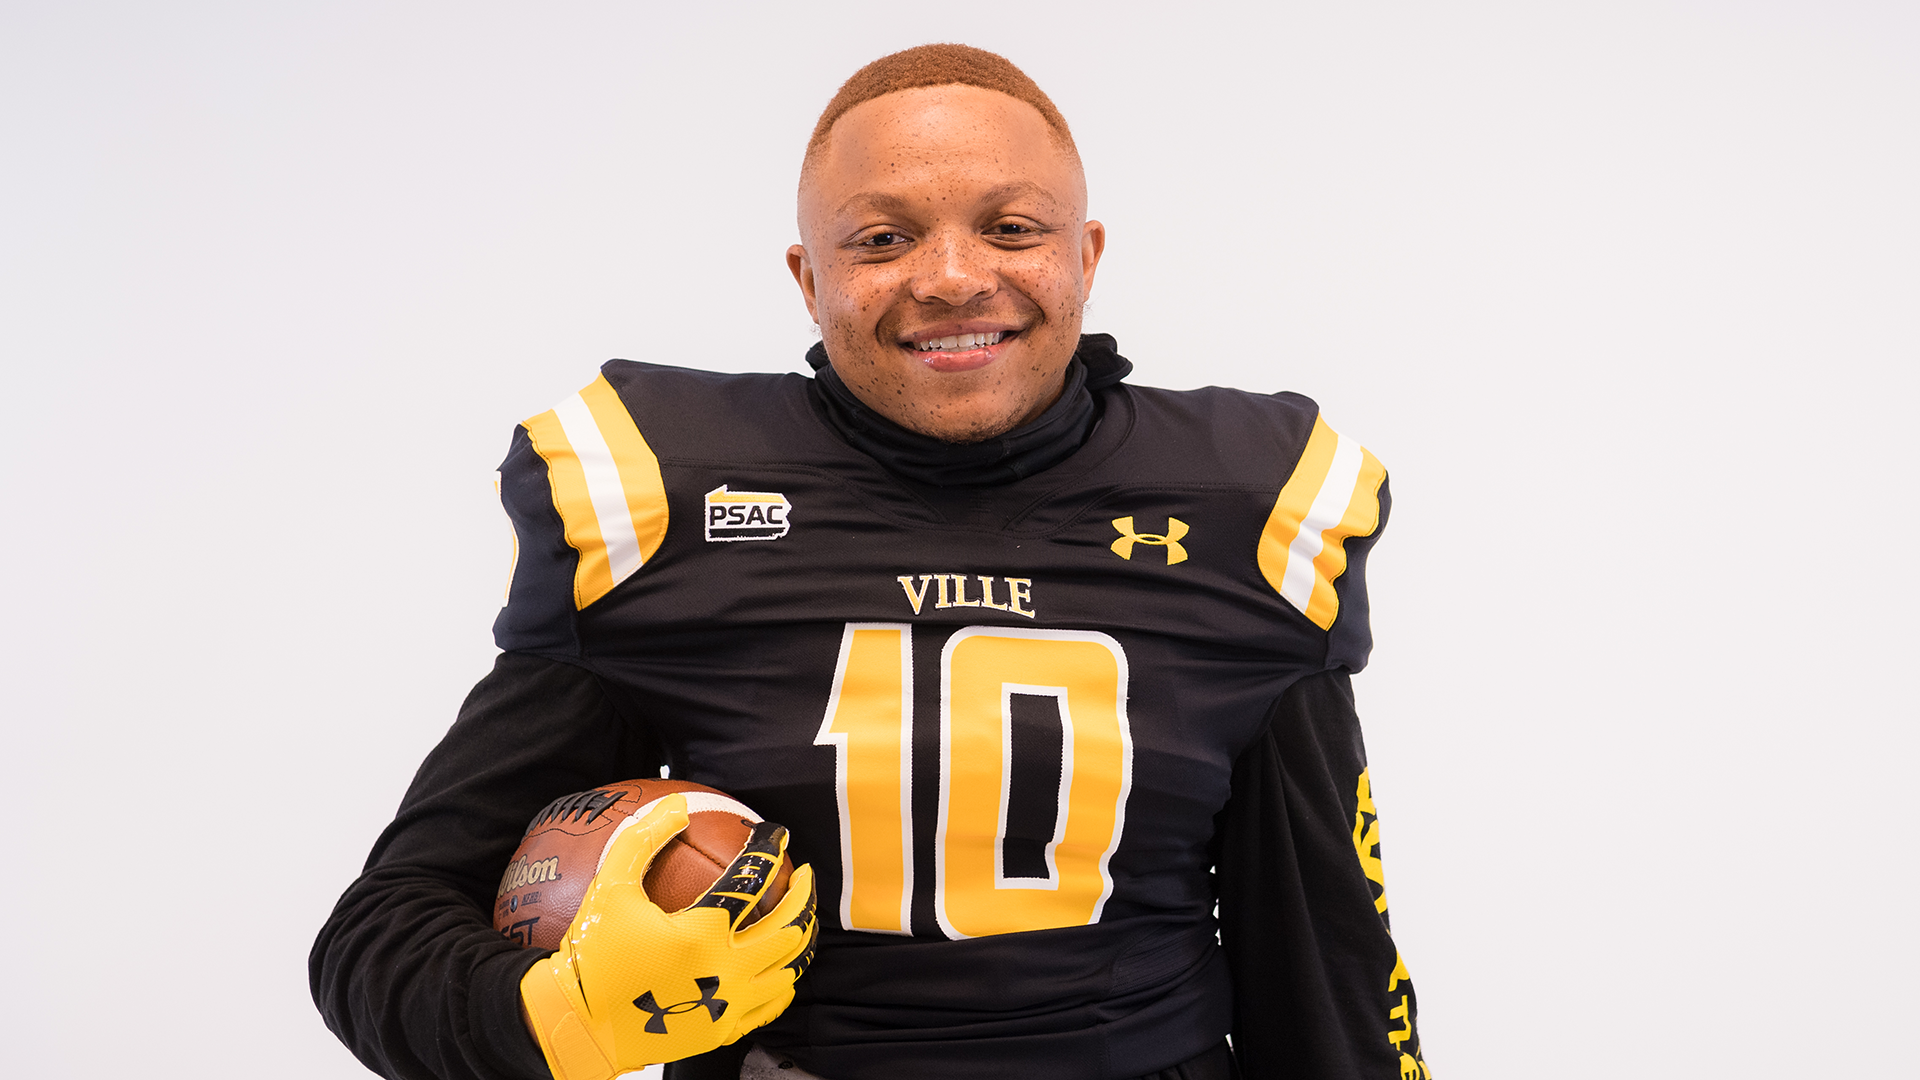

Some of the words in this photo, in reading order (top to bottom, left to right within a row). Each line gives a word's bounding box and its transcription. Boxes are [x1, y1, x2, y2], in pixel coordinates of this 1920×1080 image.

[709, 505, 783, 526] PSAC
[897, 574, 1035, 618] VILLE
[813, 622, 1133, 941] 10
